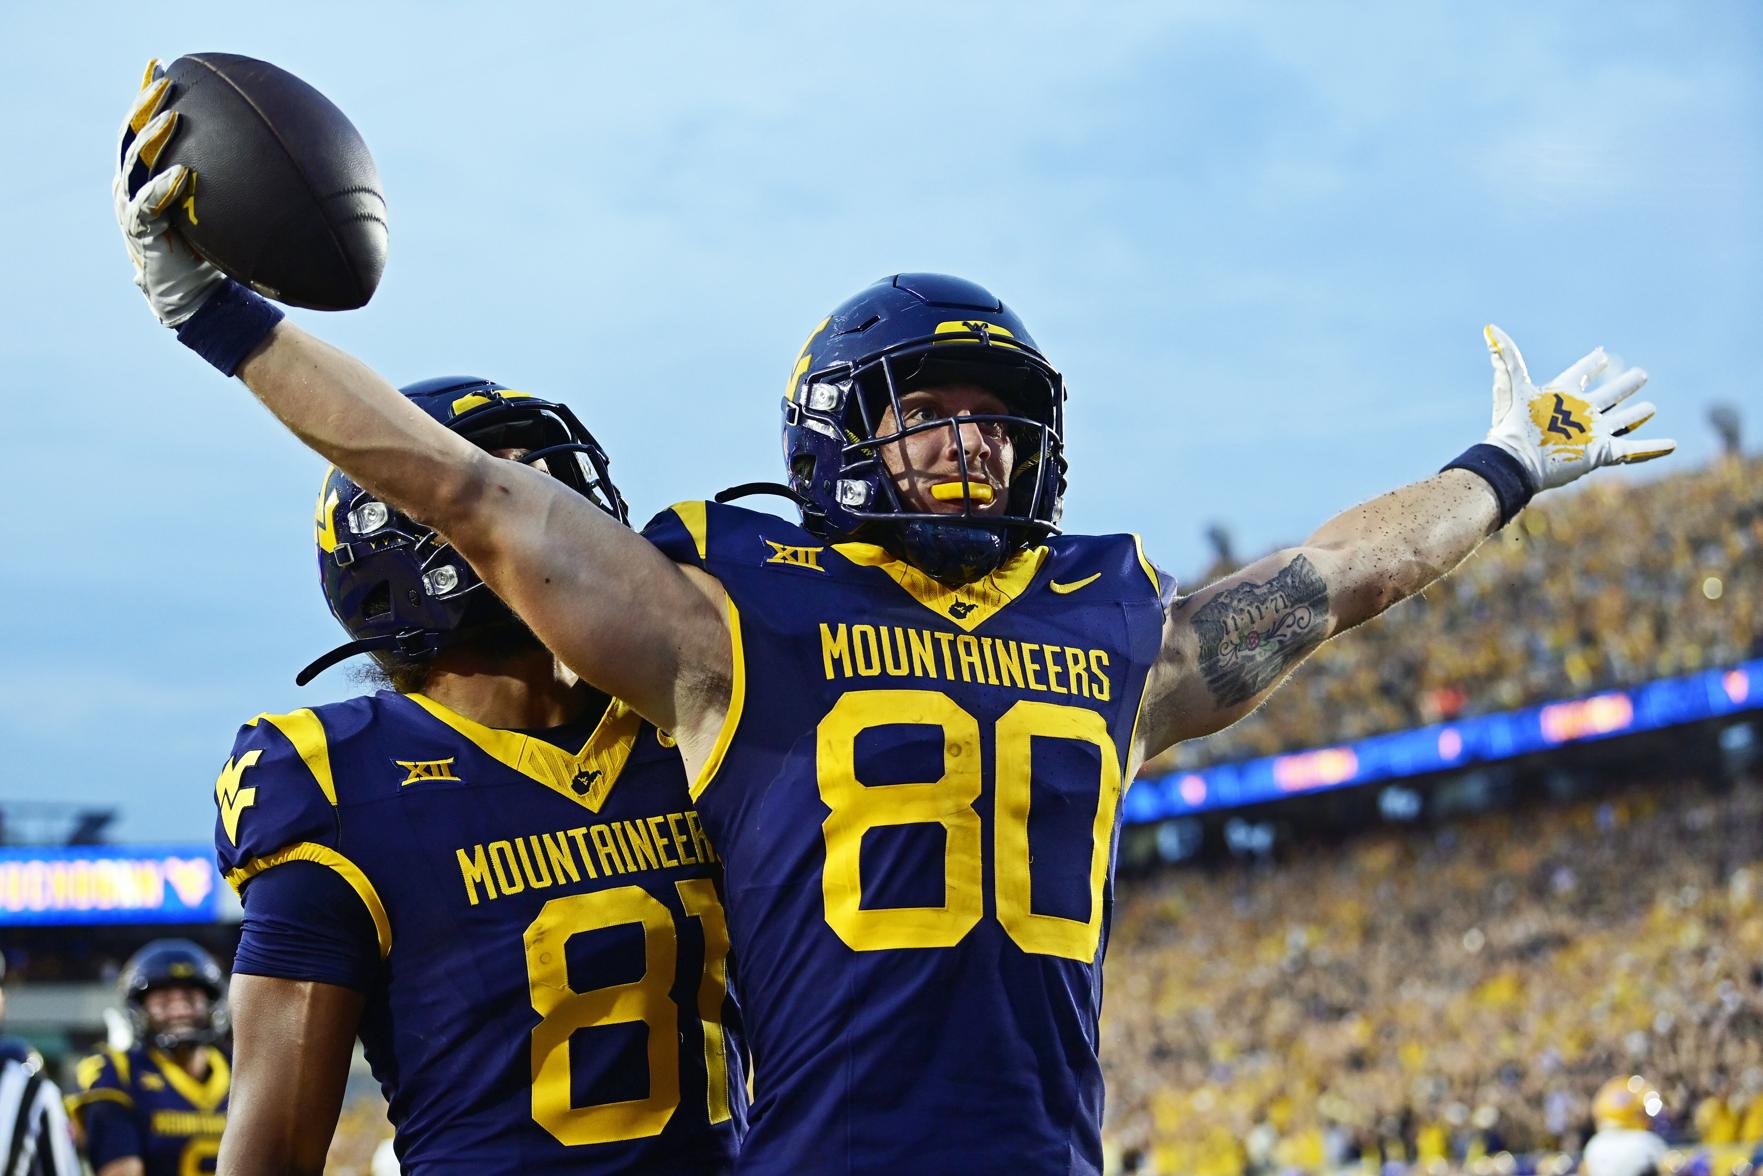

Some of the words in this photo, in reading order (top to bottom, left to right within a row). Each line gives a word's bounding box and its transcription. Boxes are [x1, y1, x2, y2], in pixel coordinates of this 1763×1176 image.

[819, 623, 1110, 702] MOUNTAINEERS
[456, 810, 720, 906] MOUNTAINEER
[816, 689, 1120, 964] 80
[523, 878, 732, 1147] 81
